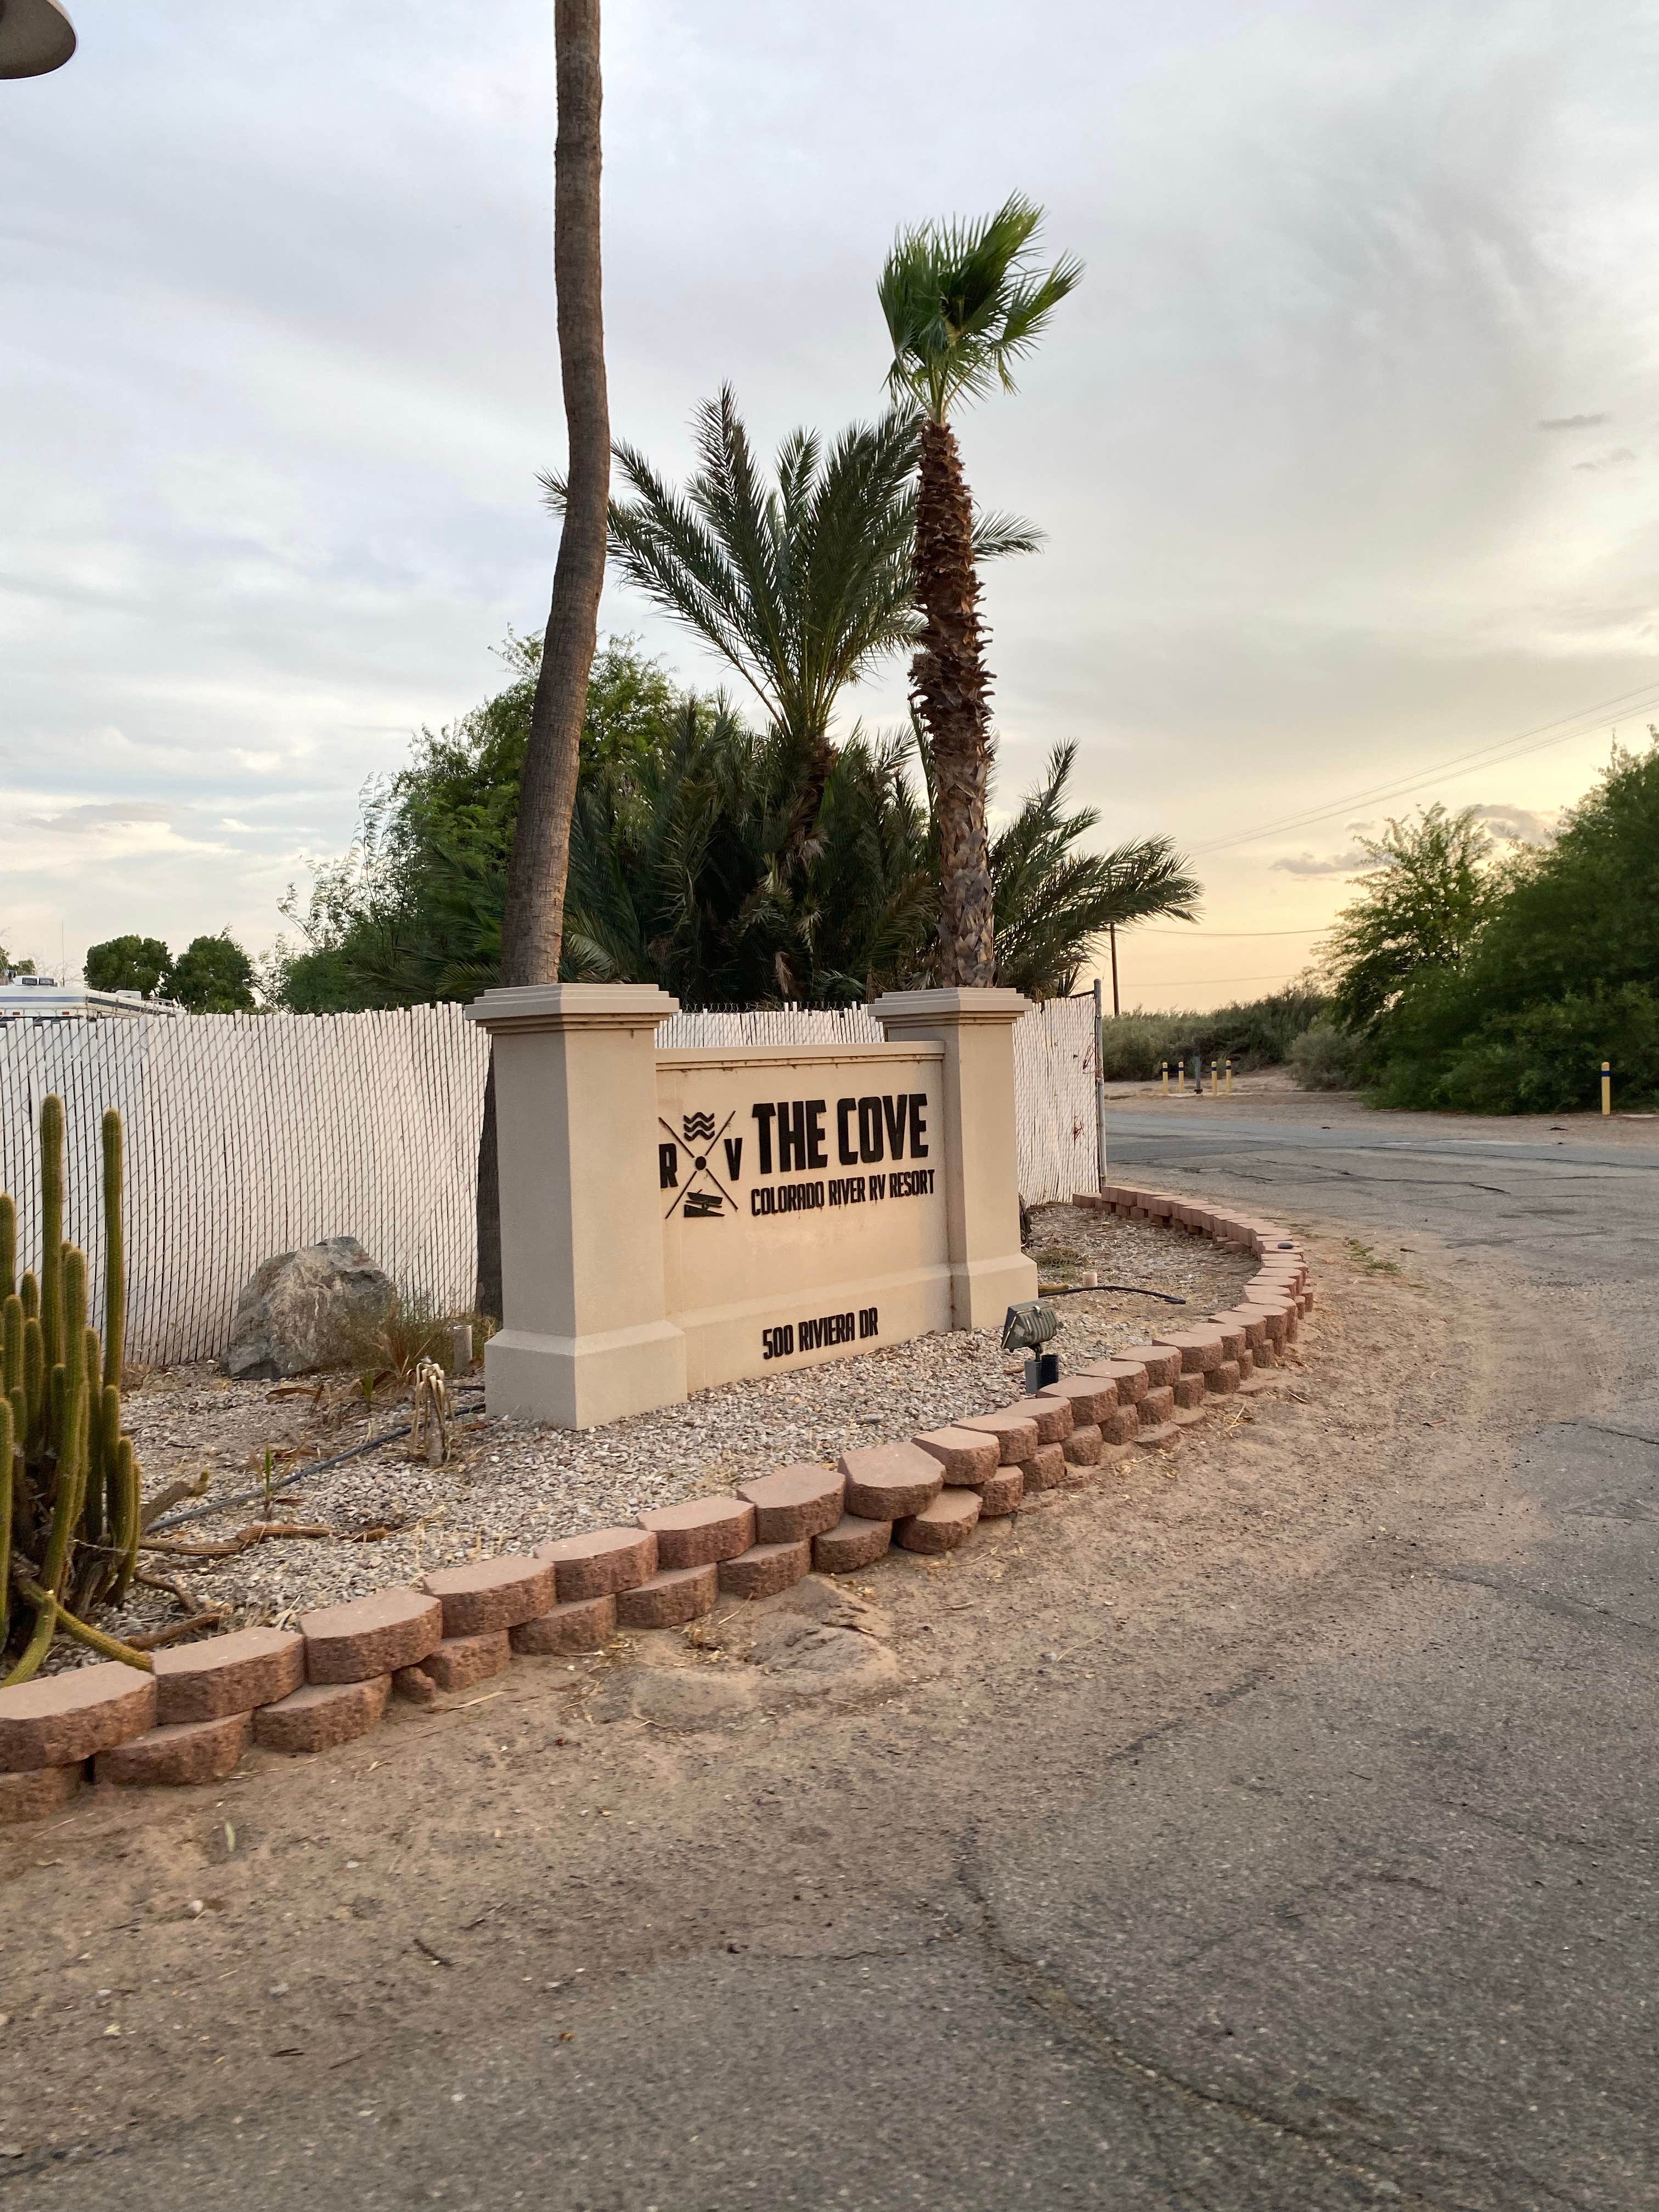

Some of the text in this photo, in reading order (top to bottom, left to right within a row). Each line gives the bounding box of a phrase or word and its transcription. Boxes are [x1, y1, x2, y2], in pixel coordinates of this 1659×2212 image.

[752, 1093, 928, 1174] THE COVE
[751, 1169, 935, 1216] COLORADO RIVER RV RESORT
[763, 1307, 878, 1359] 500 RIVIERA DR
